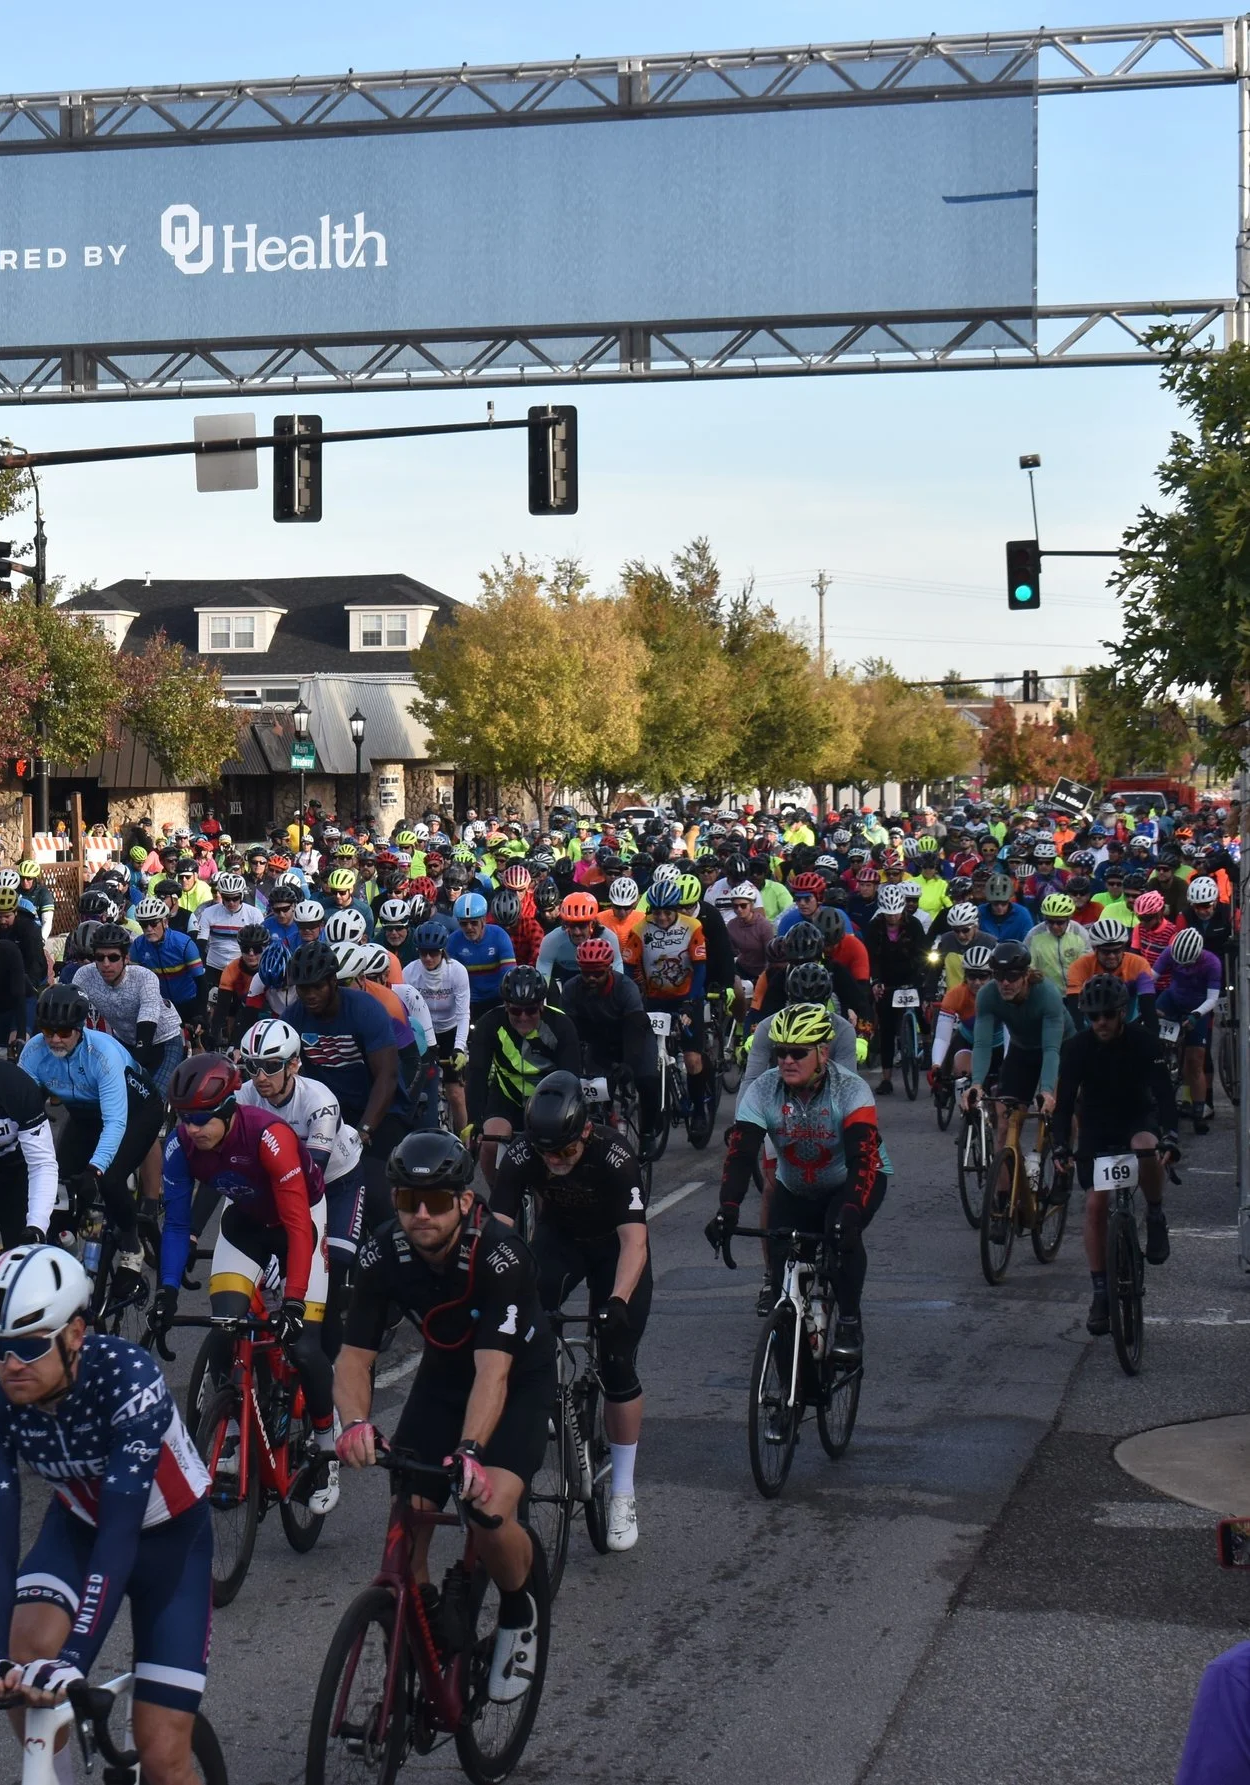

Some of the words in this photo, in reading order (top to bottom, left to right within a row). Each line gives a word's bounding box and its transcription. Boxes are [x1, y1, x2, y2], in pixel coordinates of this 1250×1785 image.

[223, 212, 388, 274] Health
[84, 245, 127, 267] BY
[294, 743, 309, 754] Main
[897, 995, 914, 1005] 332
[604, 1151, 625, 1169] ING
[1103, 1165, 1130, 1182] 169
[350, 1185, 366, 1240] UNITED
[486, 1249, 510, 1274] ING
[16, 1588, 66, 1604] ROSA
[73, 1573, 104, 1635] UNITED
